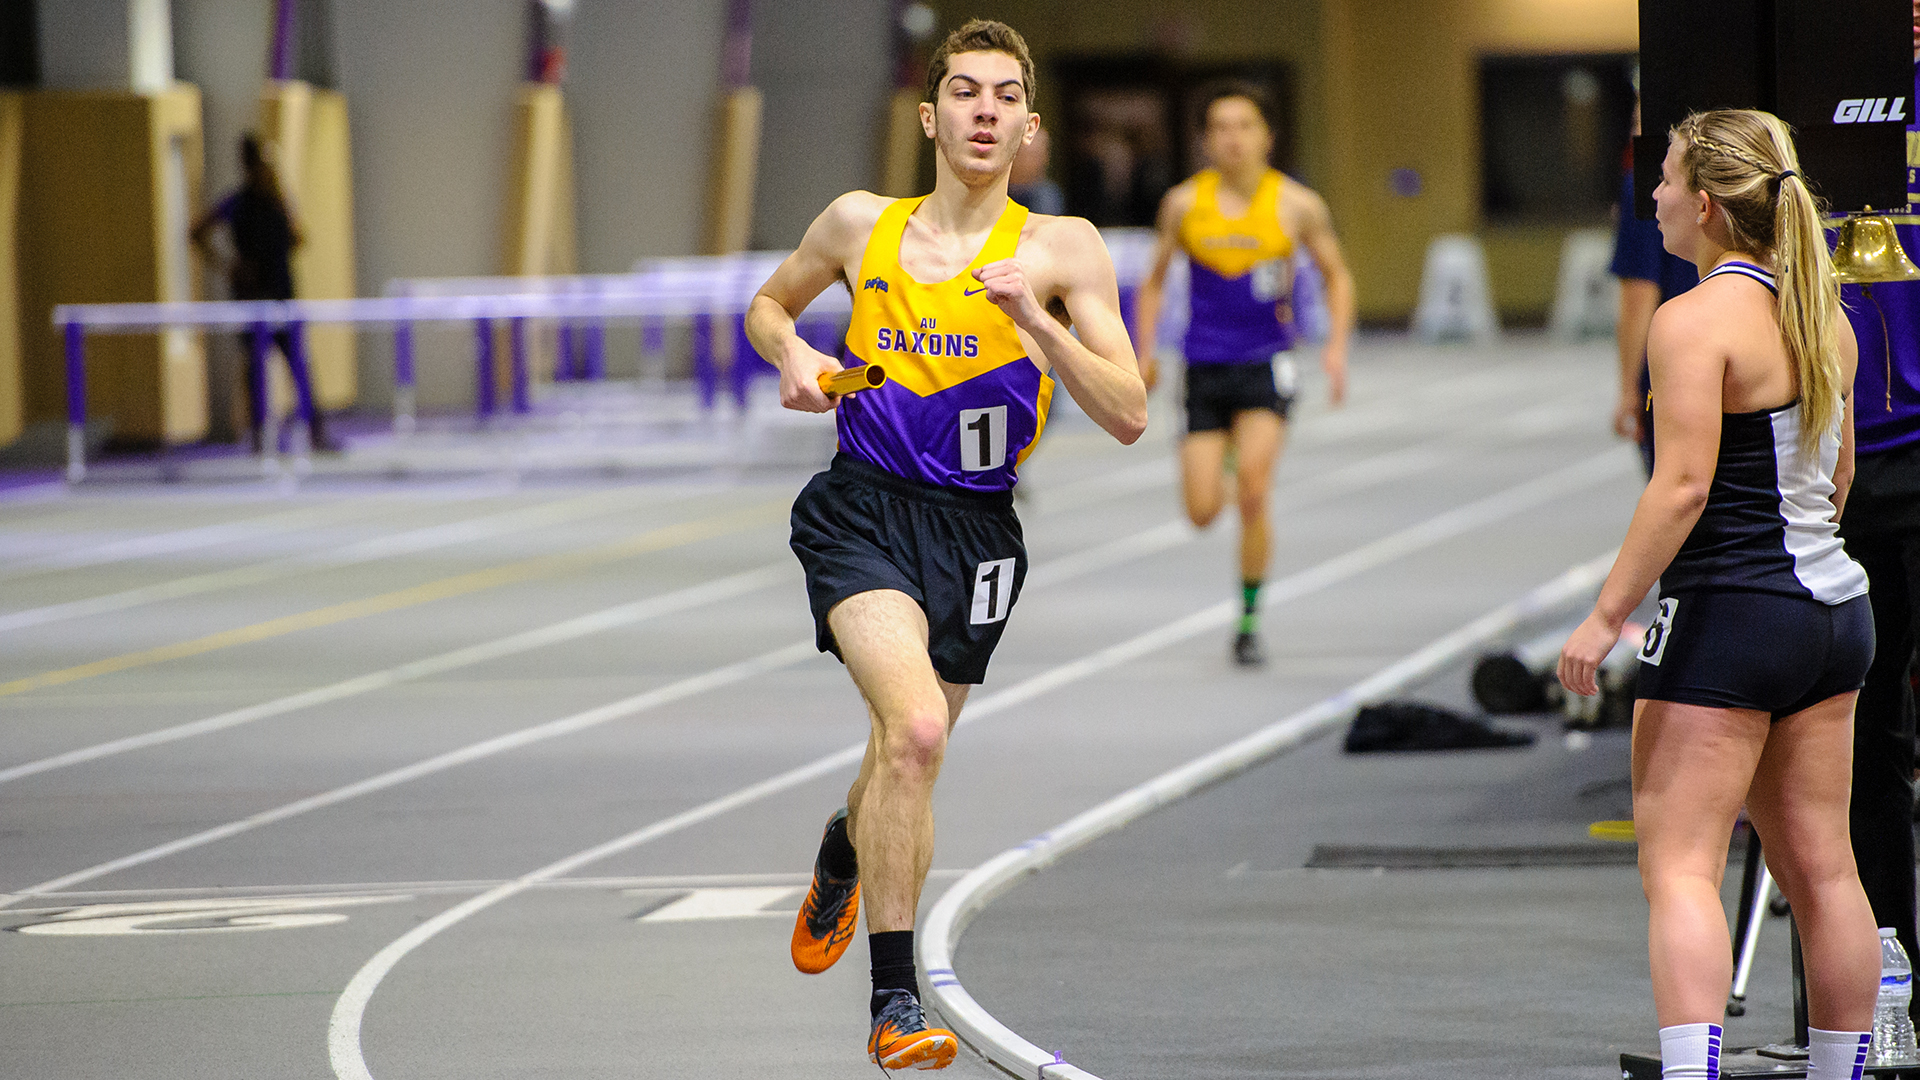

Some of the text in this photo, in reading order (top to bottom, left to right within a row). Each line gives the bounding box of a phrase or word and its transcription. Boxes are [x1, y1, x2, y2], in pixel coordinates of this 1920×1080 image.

[1833, 97, 1906, 124] GILL
[920, 317, 937, 329] AU
[877, 327, 979, 358] SAXONS
[967, 412, 992, 467] 1
[981, 564, 1002, 620] 1
